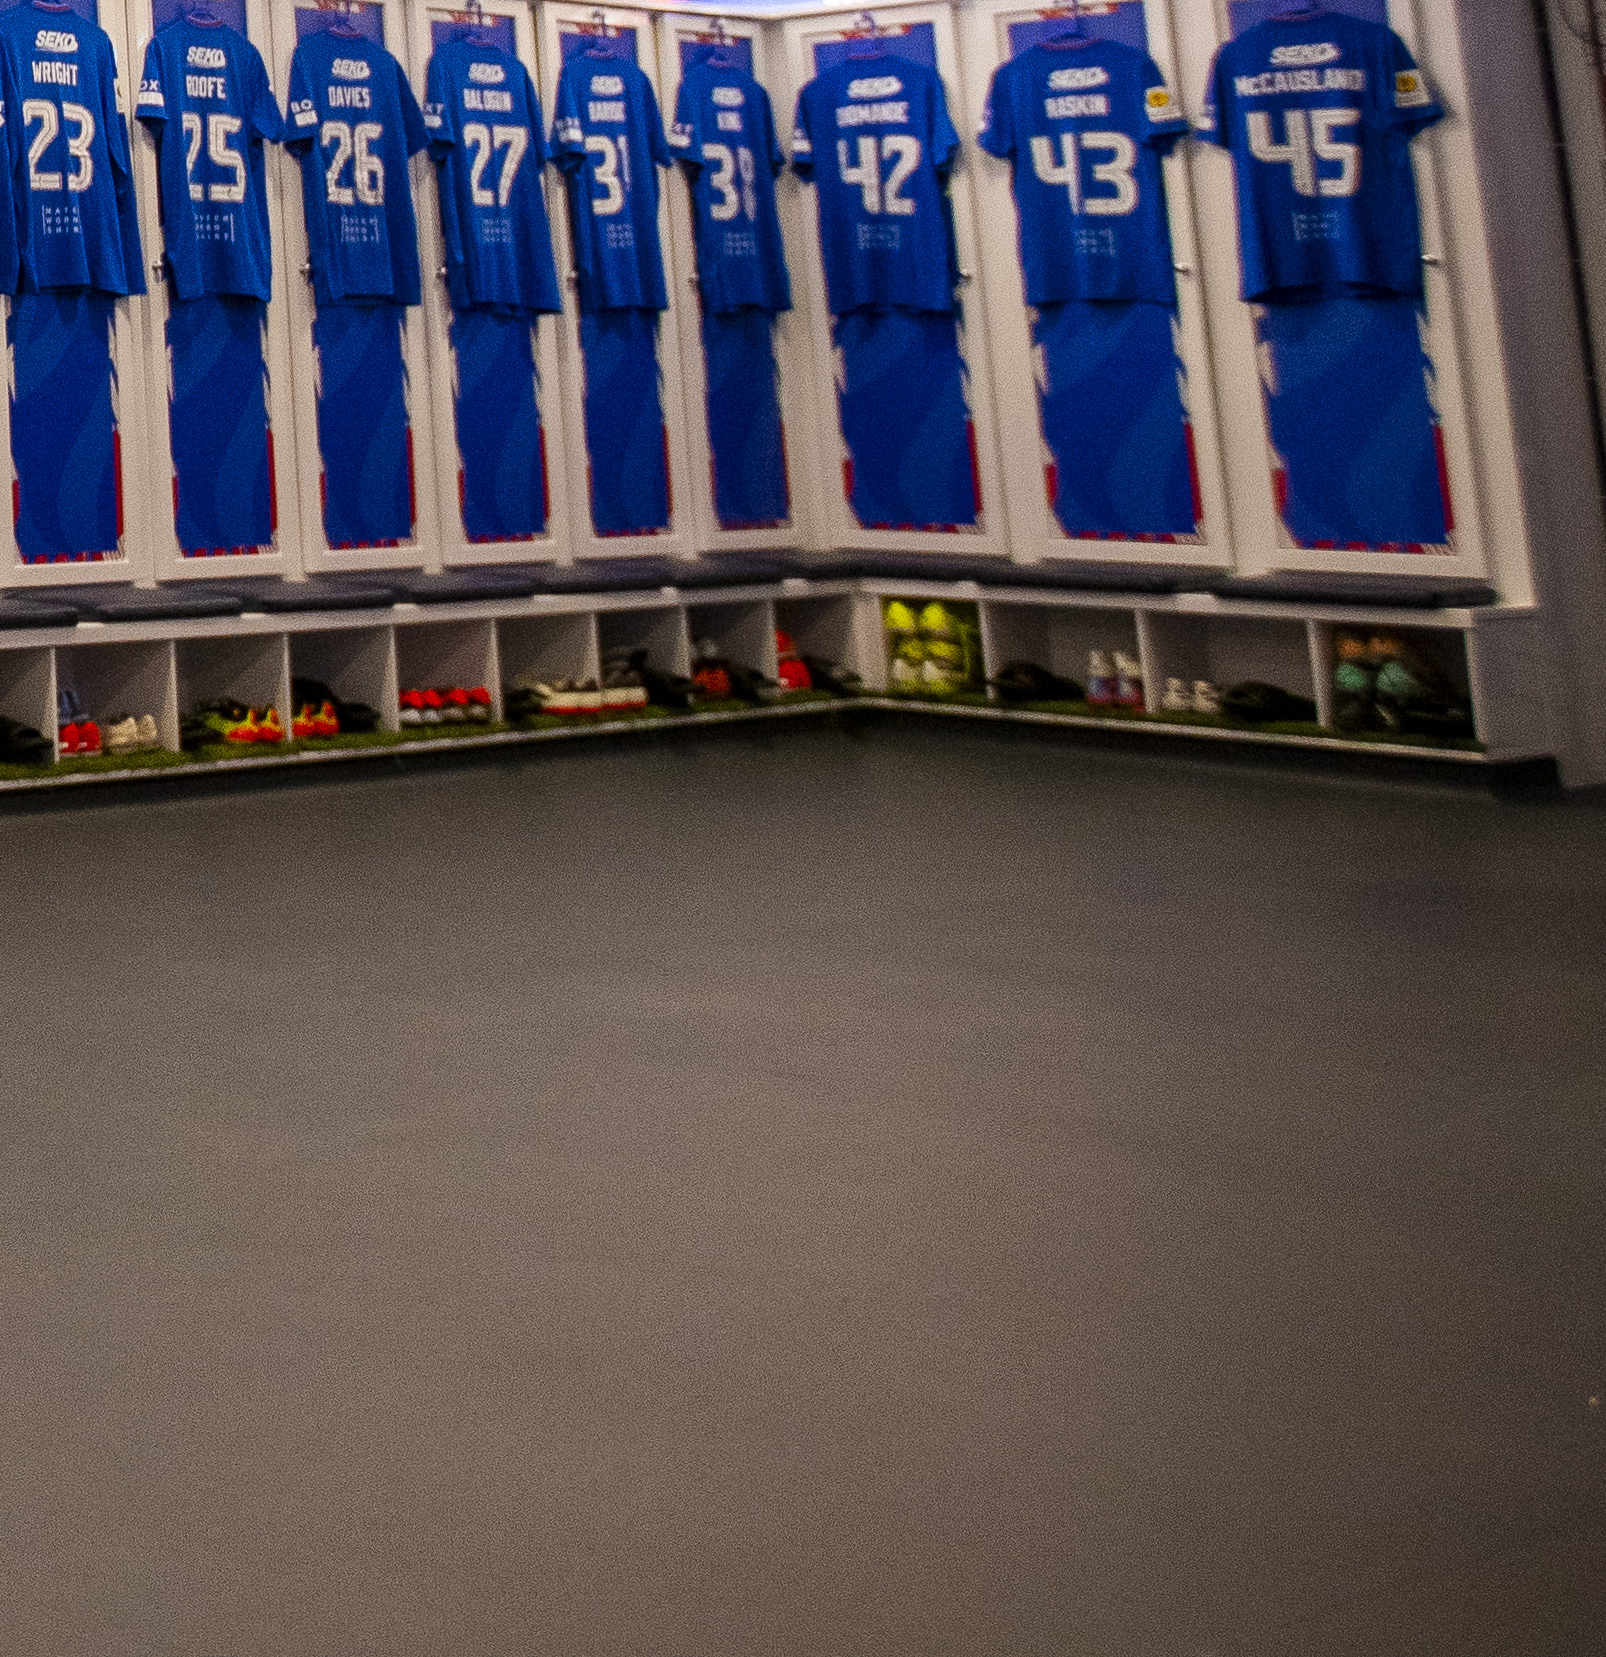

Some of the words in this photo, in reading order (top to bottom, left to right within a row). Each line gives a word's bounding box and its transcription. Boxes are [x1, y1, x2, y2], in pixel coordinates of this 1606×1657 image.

[32, 61, 78, 86] WRIGHT
[35, 30, 79, 53] SEKO
[328, 86, 371, 109] DAVIES
[22, 99, 95, 193] 23
[182, 112, 247, 203] 25
[321, 121, 386, 206] 26
[463, 122, 529, 208] 27
[836, 134, 922, 216] 42
[1029, 131, 1140, 216] 43
[1245, 108, 1363, 198] 45
